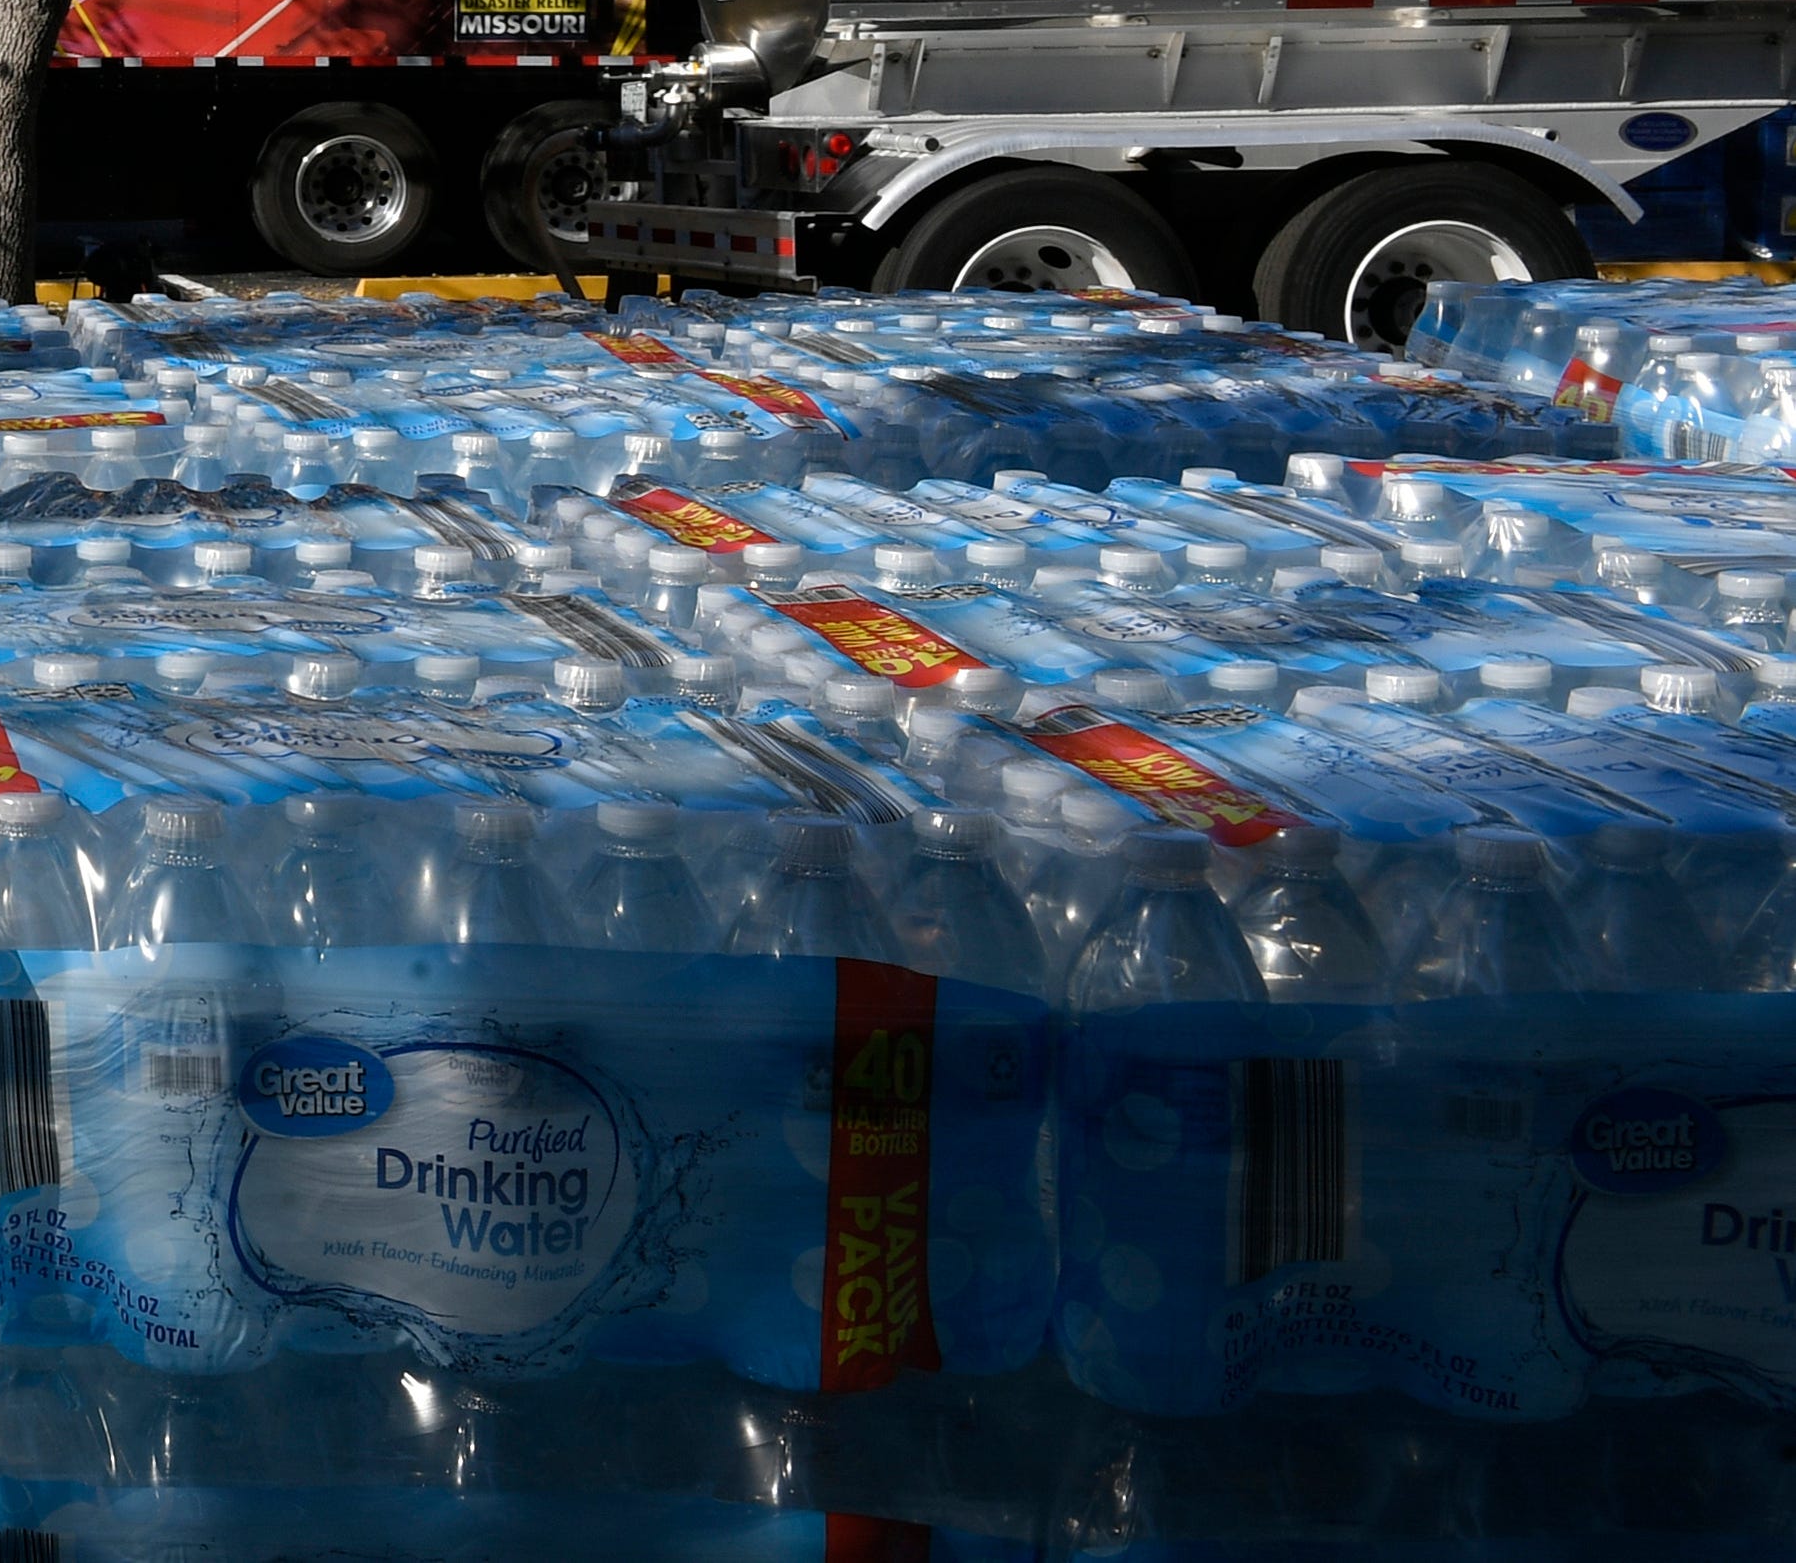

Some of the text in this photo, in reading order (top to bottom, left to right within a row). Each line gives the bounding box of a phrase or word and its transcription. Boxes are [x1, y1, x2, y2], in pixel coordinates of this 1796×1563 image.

[460, 14, 586, 35] MISSOURI
[253, 1060, 366, 1098] Great
[843, 1028, 926, 1103] 40
[276, 1088, 366, 1117] Value
[836, 1106, 888, 1130] HALF
[468, 1115, 591, 1163] Purified
[848, 1133, 920, 1157] BOTTLES
[1585, 1111, 1696, 1151] Great
[1608, 1144, 1696, 1175] Value
[377, 1147, 588, 1214] Drinking
[46, 1208, 67, 1231] OZ
[441, 1203, 590, 1256] Water
[835, 1194, 885, 1367] PACK
[138, 1296, 159, 1318] OZ
[143, 1320, 200, 1349] TOTAL
[1450, 1355, 1478, 1379] OZ
[1458, 1380, 1521, 1411] TOTAL
